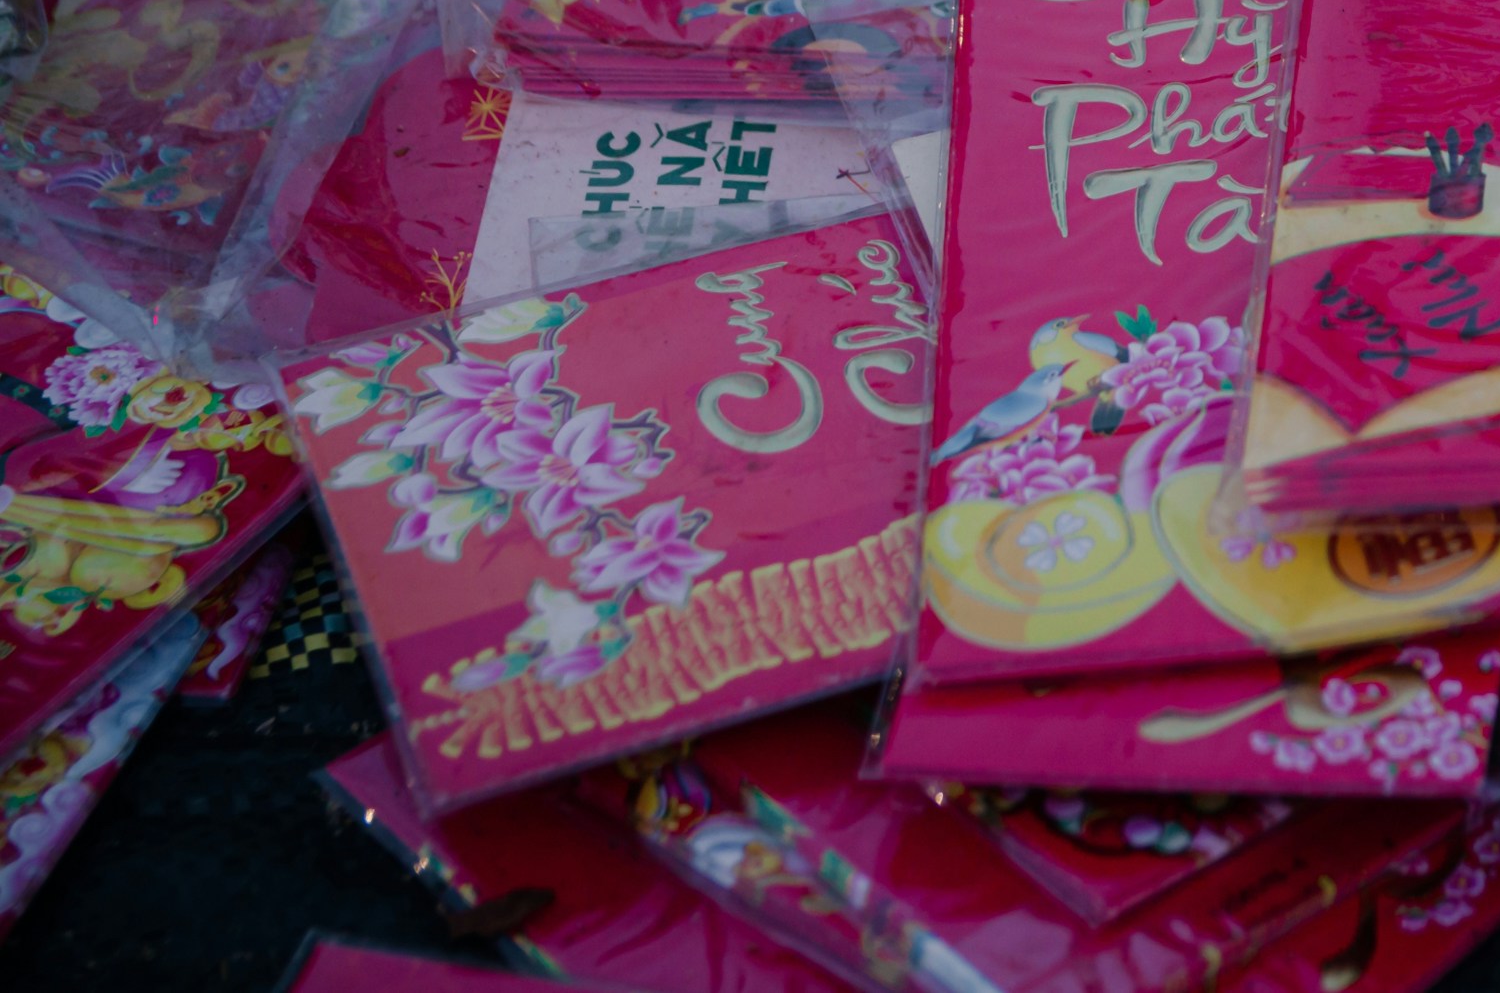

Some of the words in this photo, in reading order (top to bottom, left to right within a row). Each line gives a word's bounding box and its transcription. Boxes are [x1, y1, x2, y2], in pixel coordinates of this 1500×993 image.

[573, 130, 642, 252] CHÚC
[650, 119, 713, 187] NĂ
[1083, 158, 1267, 267] Tà
[694, 260, 824, 455] Cung
